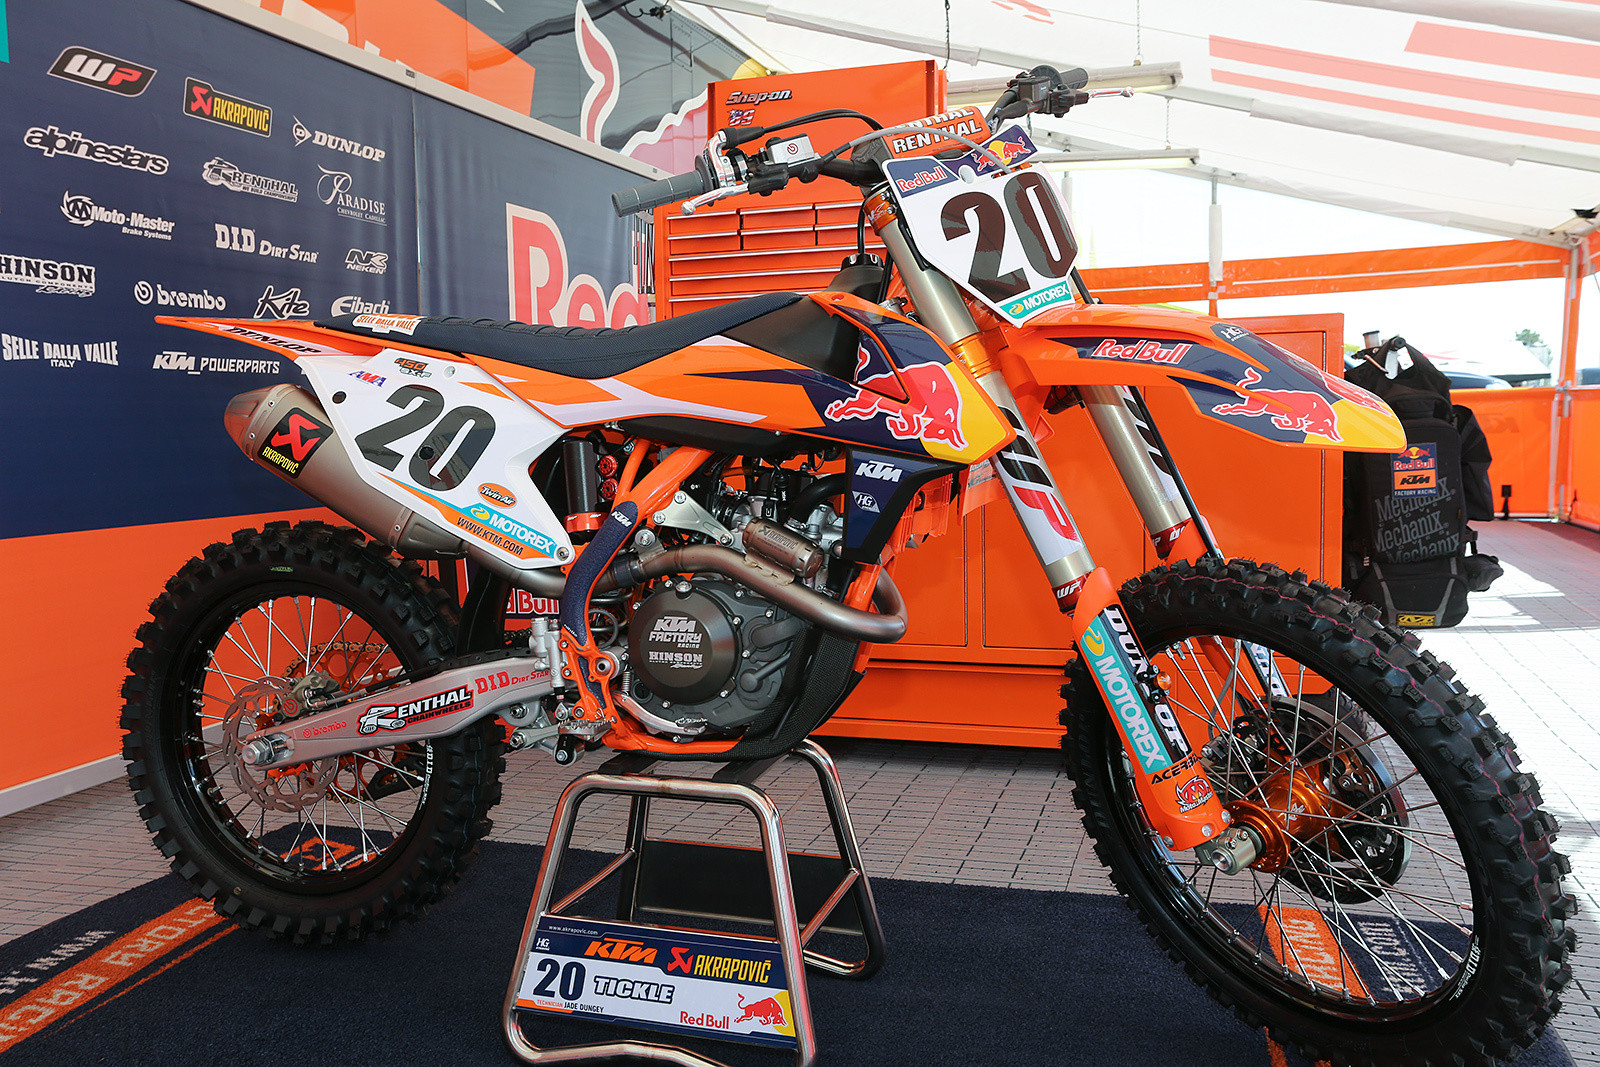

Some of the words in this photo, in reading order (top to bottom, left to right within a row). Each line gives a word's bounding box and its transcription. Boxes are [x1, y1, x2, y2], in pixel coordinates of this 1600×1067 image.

[64, 54, 142, 86] WP
[726, 90, 792, 105] Snap-on
[24, 126, 169, 175] alpinestars
[312, 130, 386, 162] DUNLOP
[896, 174, 923, 193] Red
[919, 166, 947, 184] Bull
[90, 206, 176, 234] Moto-Master
[122, 226, 143, 236] Brake
[144, 229, 172, 241] Systems
[941, 172, 1079, 304] 20
[346, 264, 386, 275] NEKEN
[156, 284, 227, 311] brembo
[331, 296, 389, 317] Eibach
[1023, 283, 1070, 311] MOTOREX
[1, 334, 40, 361] SELLE
[43, 342, 82, 361] DALLA
[84, 341, 119, 366] VALLE
[223, 327, 322, 355] DUNLOP
[1091, 339, 1139, 359] Red
[1137, 340, 1191, 364] Bull
[50, 359, 75, 368] ITALY
[348, 371, 387, 388] AMA
[354, 384, 495, 491] 20
[855, 460, 904, 483] KTM
[1394, 460, 1416, 471] Red
[1415, 458, 1436, 469] Bull
[1400, 475, 1430, 485] KTM
[481, 486, 501, 501] Twin
[499, 495, 516, 506] Air
[611, 511, 633, 527] KTM
[456, 516, 524, 556] WWW.KTM.COM
[489, 513, 556, 554] MOTOREX
[653, 616, 696, 632] KTM
[649, 631, 702, 644] FACTORY
[649, 651, 703, 663] HINSON
[406, 701, 472, 725] CHAINWHEELS
[1096, 659, 1166, 768] MOTOREX
[312, 721, 347, 737] brembo
[584, 937, 658, 964] KTM
[532, 958, 587, 1001] 20
[693, 954, 772, 984] AKRAPOVIČ
[593, 975, 676, 1005] TICKLE
[563, 1001, 578, 1011] JADE
[579, 1003, 604, 1014] DUNGEY
[680, 1011, 706, 1027] Red
[705, 1014, 730, 1031] Bull
